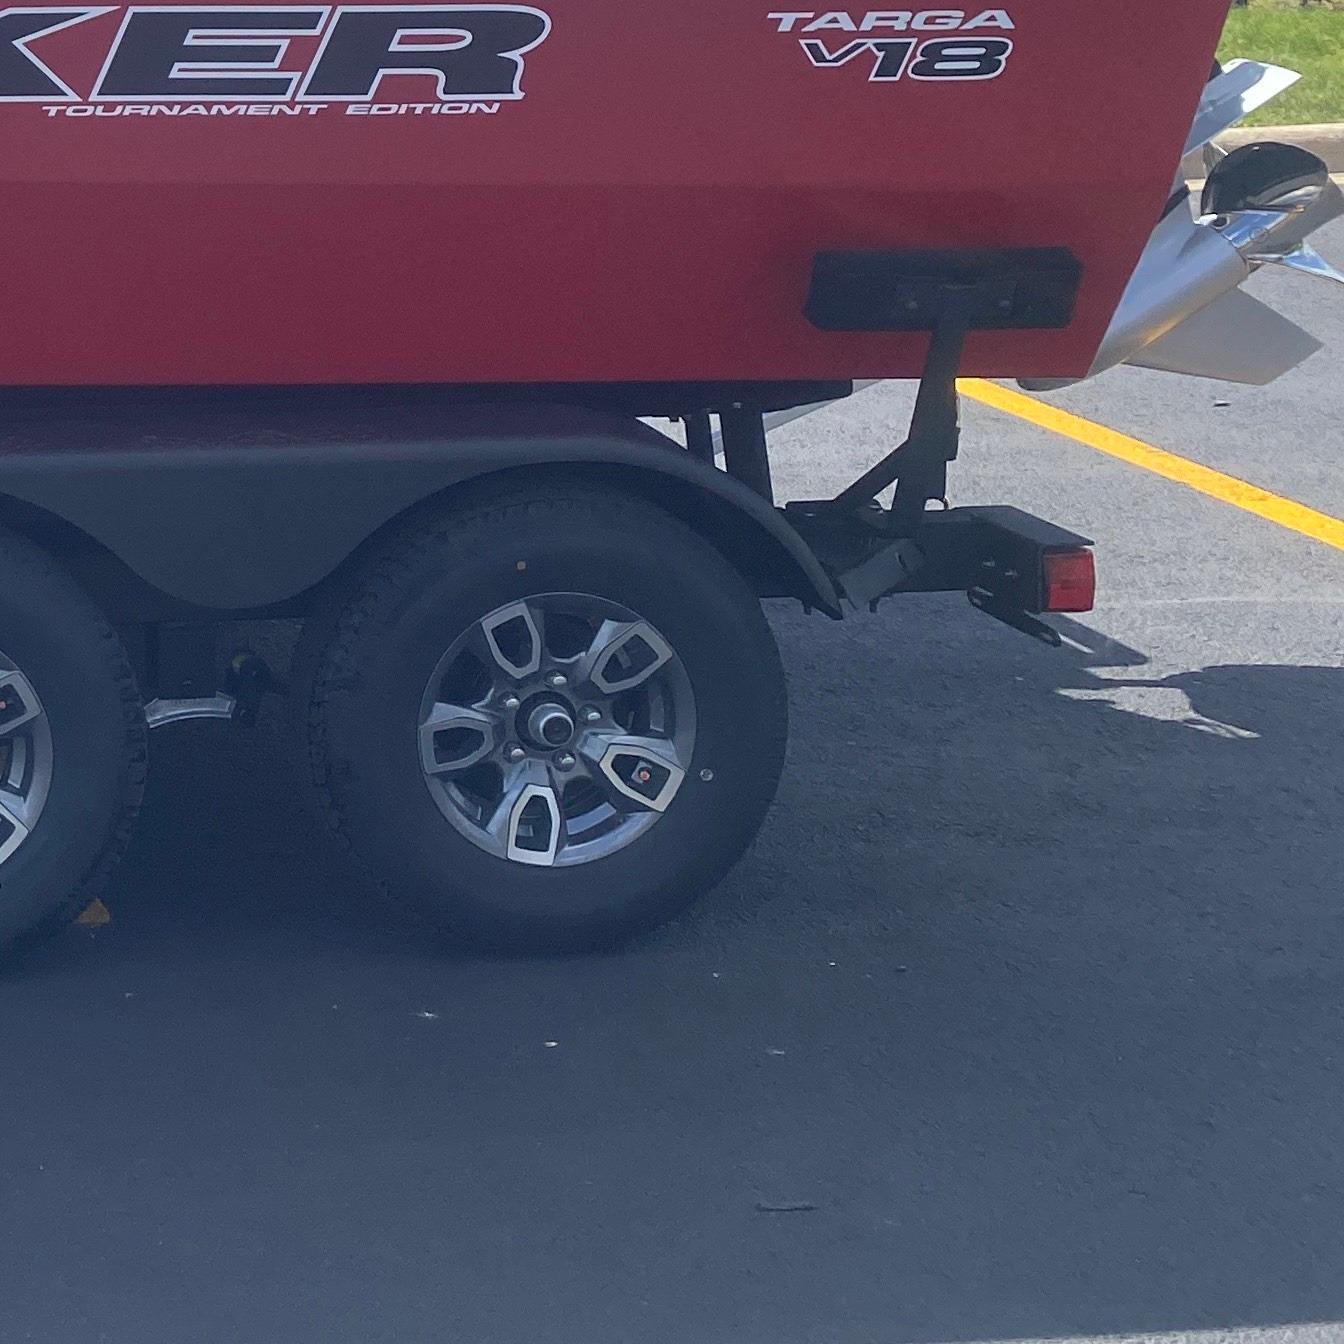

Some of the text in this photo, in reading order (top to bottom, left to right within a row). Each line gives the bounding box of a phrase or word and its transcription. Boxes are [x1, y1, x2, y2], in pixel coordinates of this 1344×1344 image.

[766, 8, 1016, 33] TARGA
[798, 36, 1014, 83] V18
[41, 101, 502, 118] TOURNAMENT EDITION
